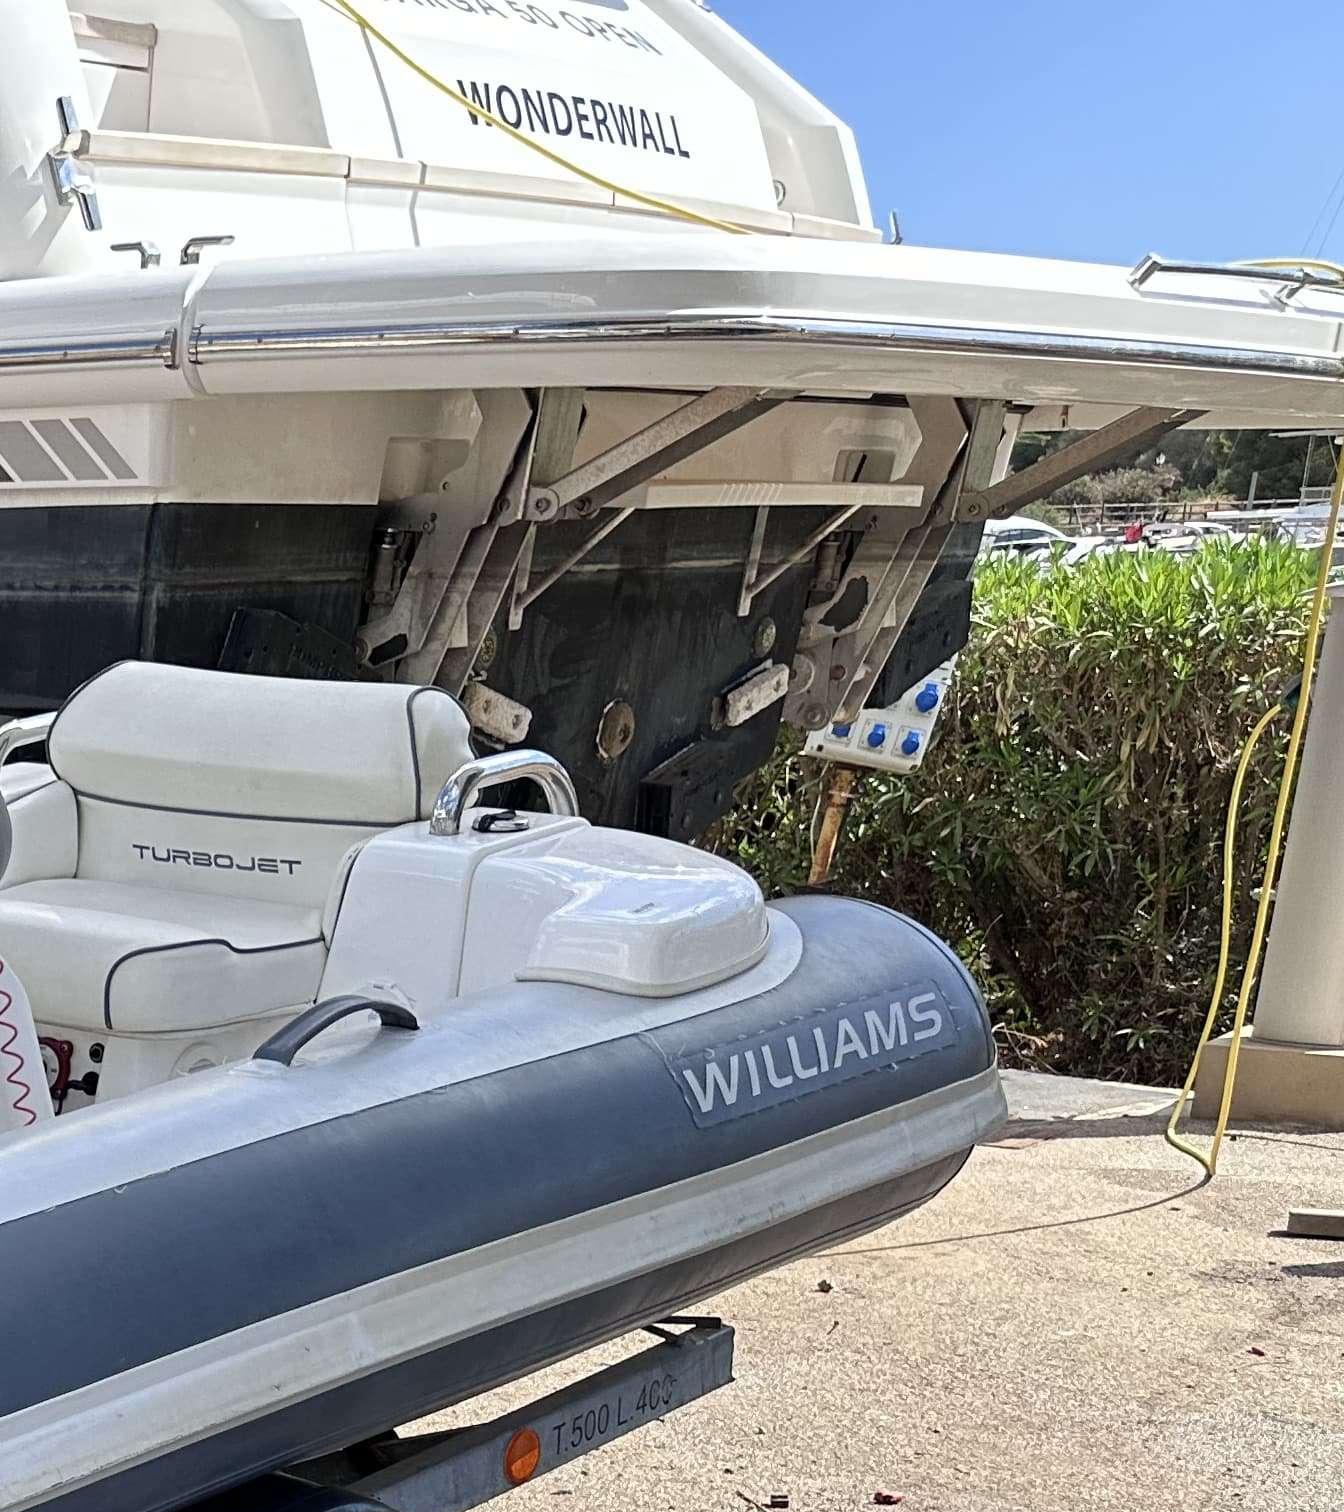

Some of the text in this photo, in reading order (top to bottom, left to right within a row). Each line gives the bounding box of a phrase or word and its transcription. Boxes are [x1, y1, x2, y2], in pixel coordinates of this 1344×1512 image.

[559, 10, 663, 56] OPEN
[456, 79, 691, 159] WONDERWALL
[132, 843, 302, 876] TURBOJET
[682, 992, 942, 1113] WILLIAMS
